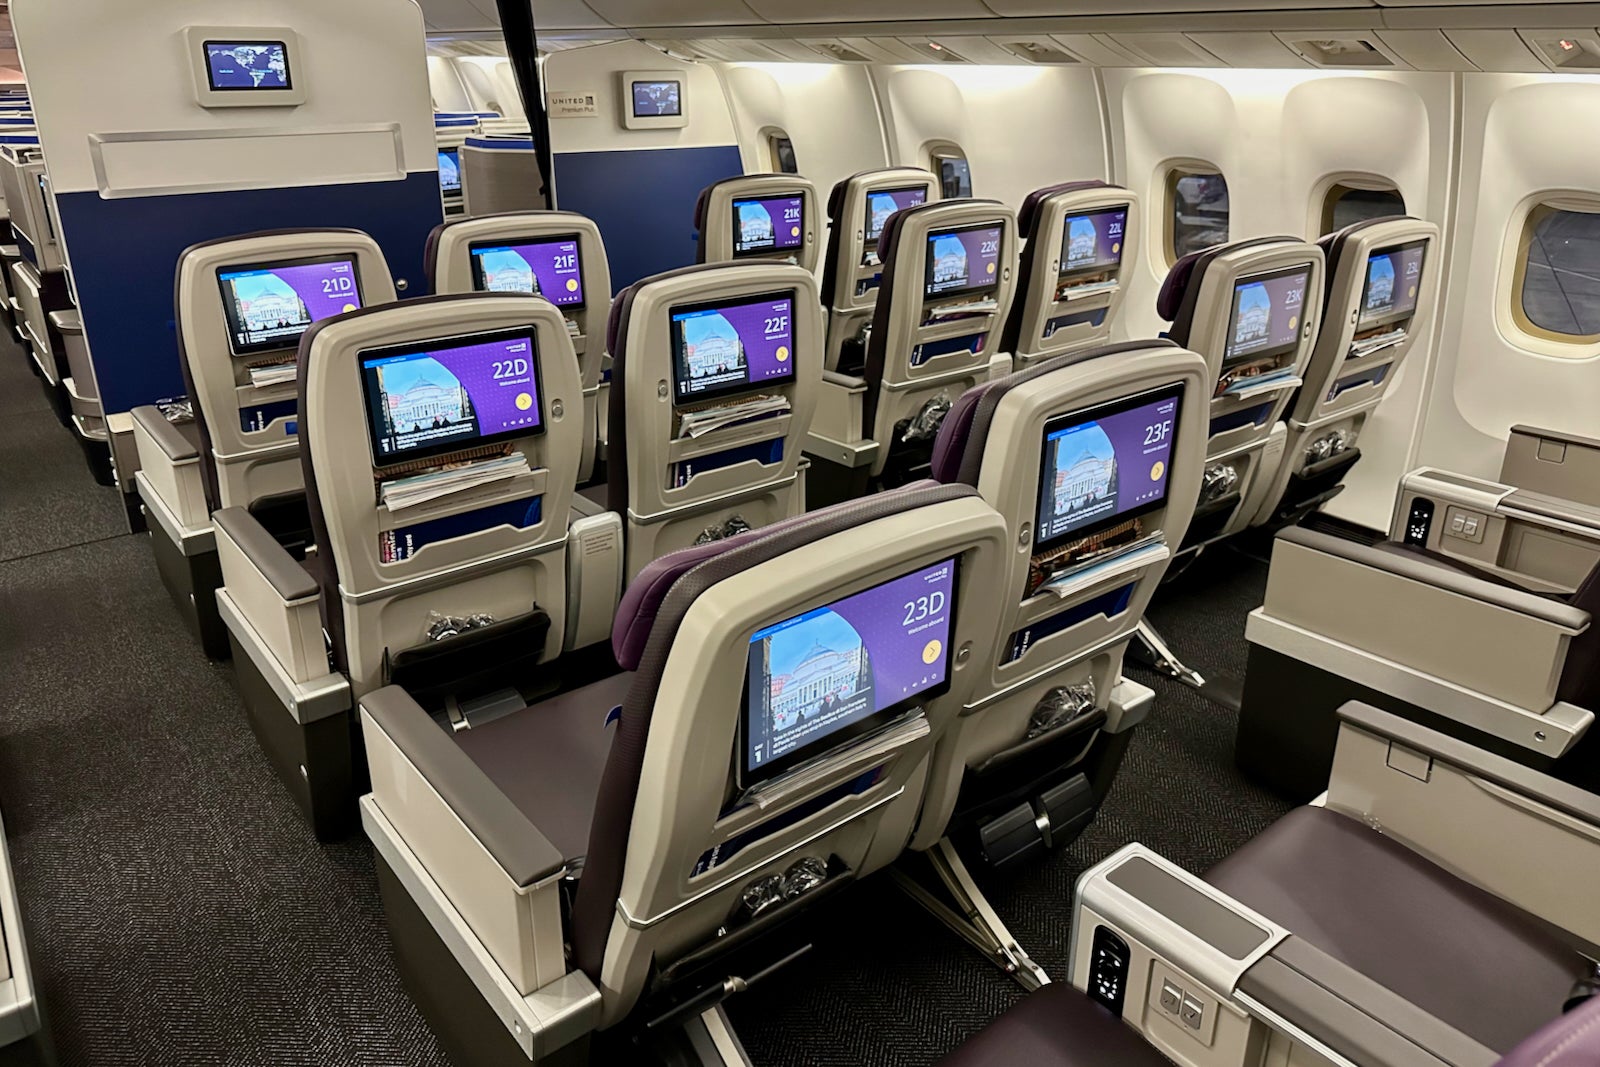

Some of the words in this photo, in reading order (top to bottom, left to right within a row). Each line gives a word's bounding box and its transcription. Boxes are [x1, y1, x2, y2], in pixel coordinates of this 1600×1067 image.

[784, 208, 800, 219] 21K
[980, 241, 998, 254] 22K
[554, 254, 575, 269] 21F
[321, 277, 352, 293] 21D
[1285, 289, 1303, 304] 23K
[764, 316, 788, 334] 22F
[492, 358, 528, 380] 22D
[1143, 420, 1171, 446] 23F
[902, 590, 945, 626] 23D
[908, 623, 929, 635] Welcome
[929, 616, 944, 627] aboard
[755, 750, 762, 762] 1
